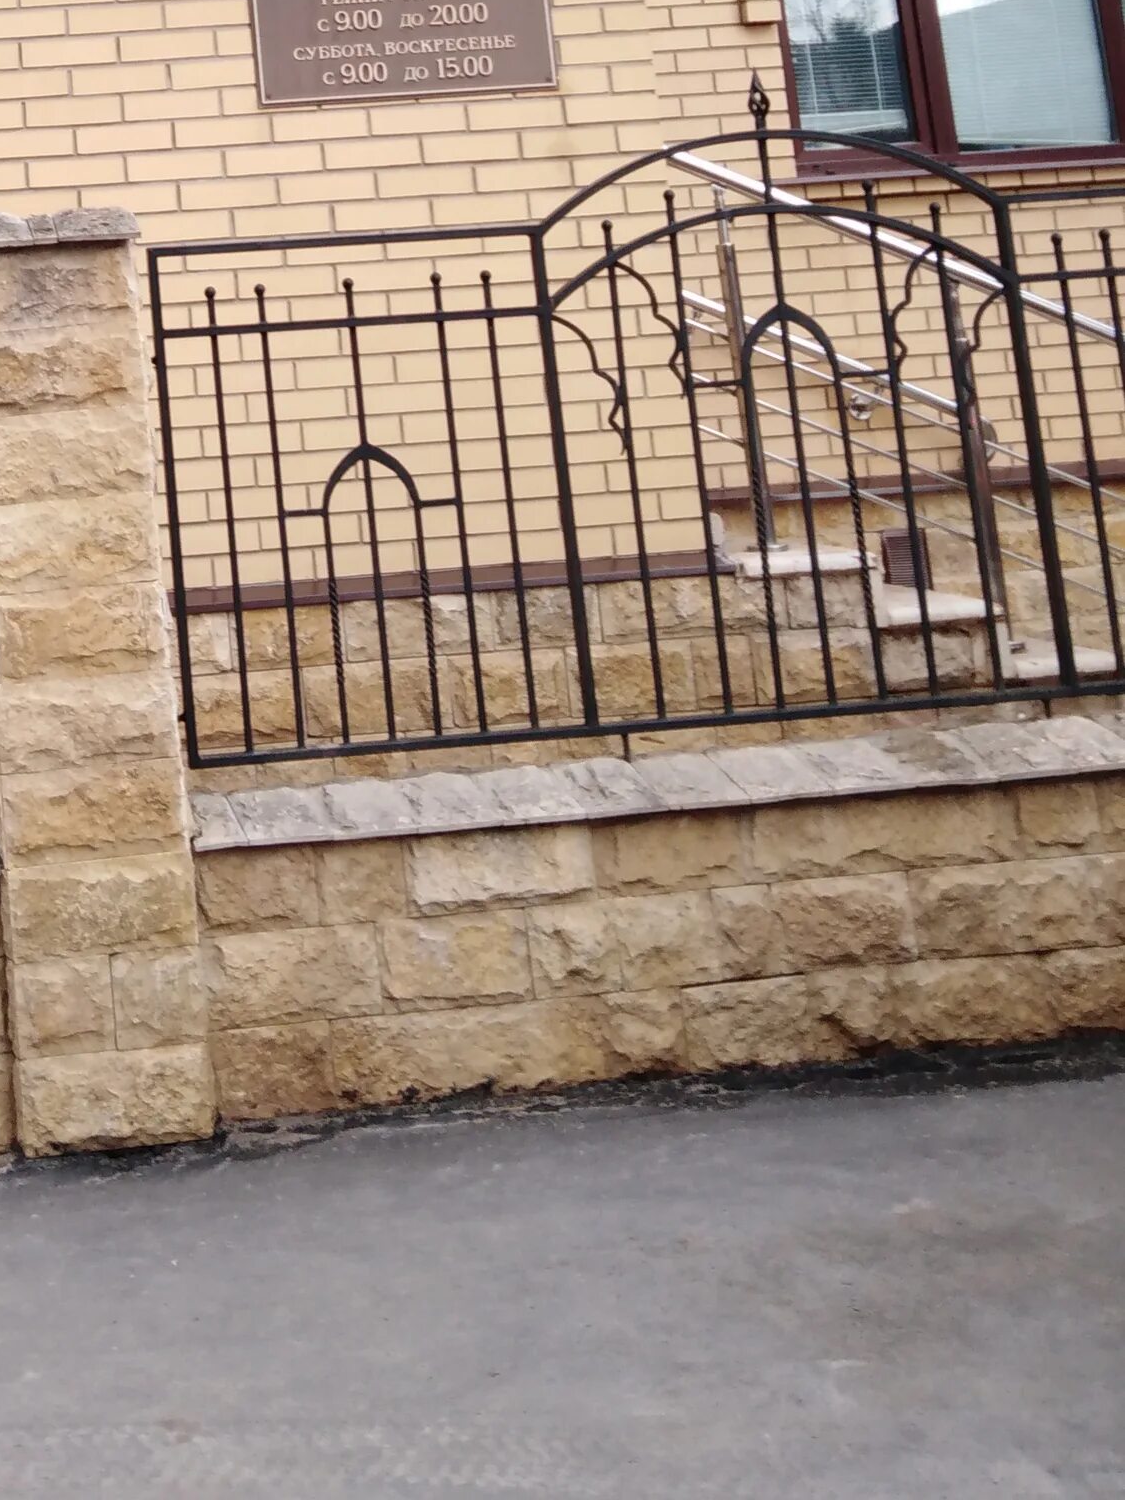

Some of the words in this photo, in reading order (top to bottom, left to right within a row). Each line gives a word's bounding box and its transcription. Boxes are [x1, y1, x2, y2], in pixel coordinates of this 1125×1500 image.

[333, 8, 384, 33] 9.00
[428, 2, 490, 27] 20.00
[384, 34, 518, 57] ВОСКРЕСЕНЬЕ
[339, 61, 389, 86] 9.00
[436, 54, 494, 80] 15.00
